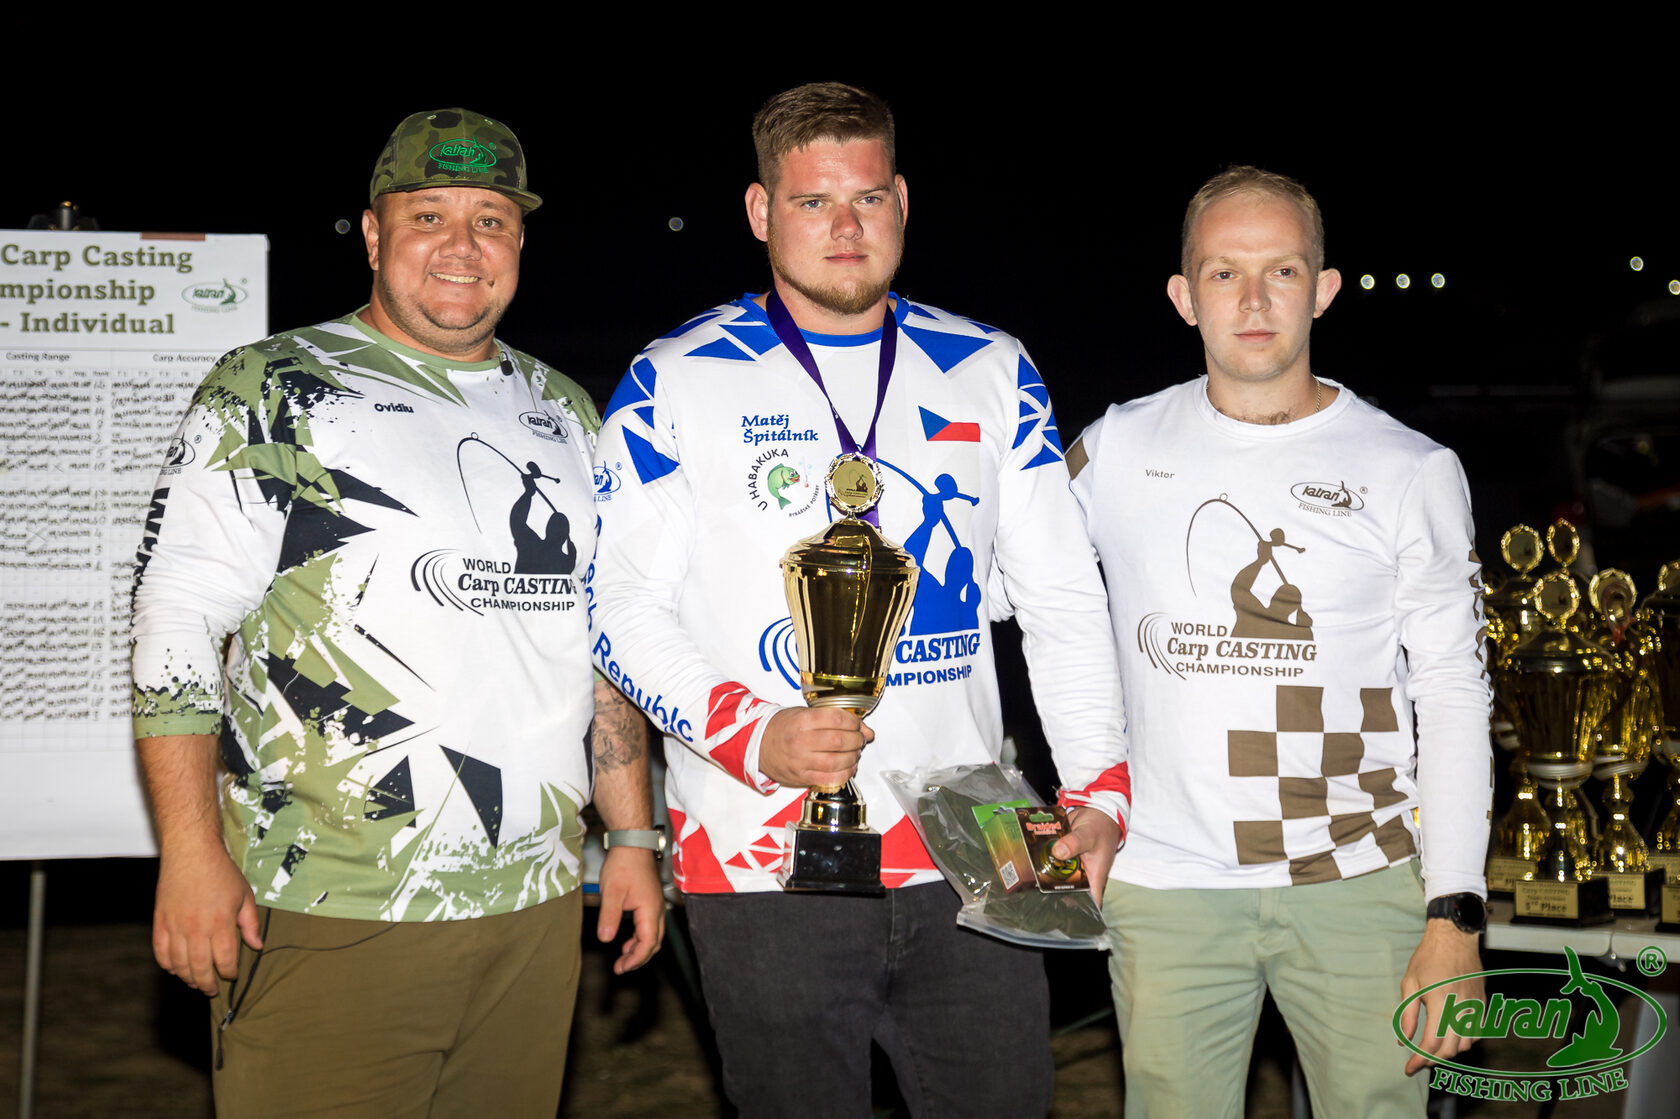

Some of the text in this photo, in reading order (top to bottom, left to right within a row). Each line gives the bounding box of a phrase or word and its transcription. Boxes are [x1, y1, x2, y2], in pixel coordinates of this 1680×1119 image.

[1, 243, 193, 273] Carp Casting
[0, 278, 155, 306] mpionship
[20, 312, 175, 334] Individual
[6, 352, 70, 362] Casting Range
[374, 403, 414, 414] Ovidiu
[741, 415, 789, 429] Matěj
[743, 428, 818, 446] Špitálník
[748, 448, 789, 500] HABAKUKA
[1145, 469, 1176, 479] Viktor
[1298, 502, 1331, 516] FISHING
[462, 557, 512, 574] WORLD
[458, 573, 577, 596] Carp CASTIN
[470, 597, 575, 612] CHAMPIONSHIP
[1171, 622, 1228, 638] WORLD
[895, 633, 981, 664] CASTING
[1167, 637, 1317, 661] Carp CASTING
[886, 664, 972, 687] MPIONSHIP
[1176, 661, 1304, 677] CHAMPIONSHIP
[593, 631, 694, 743] Republic
